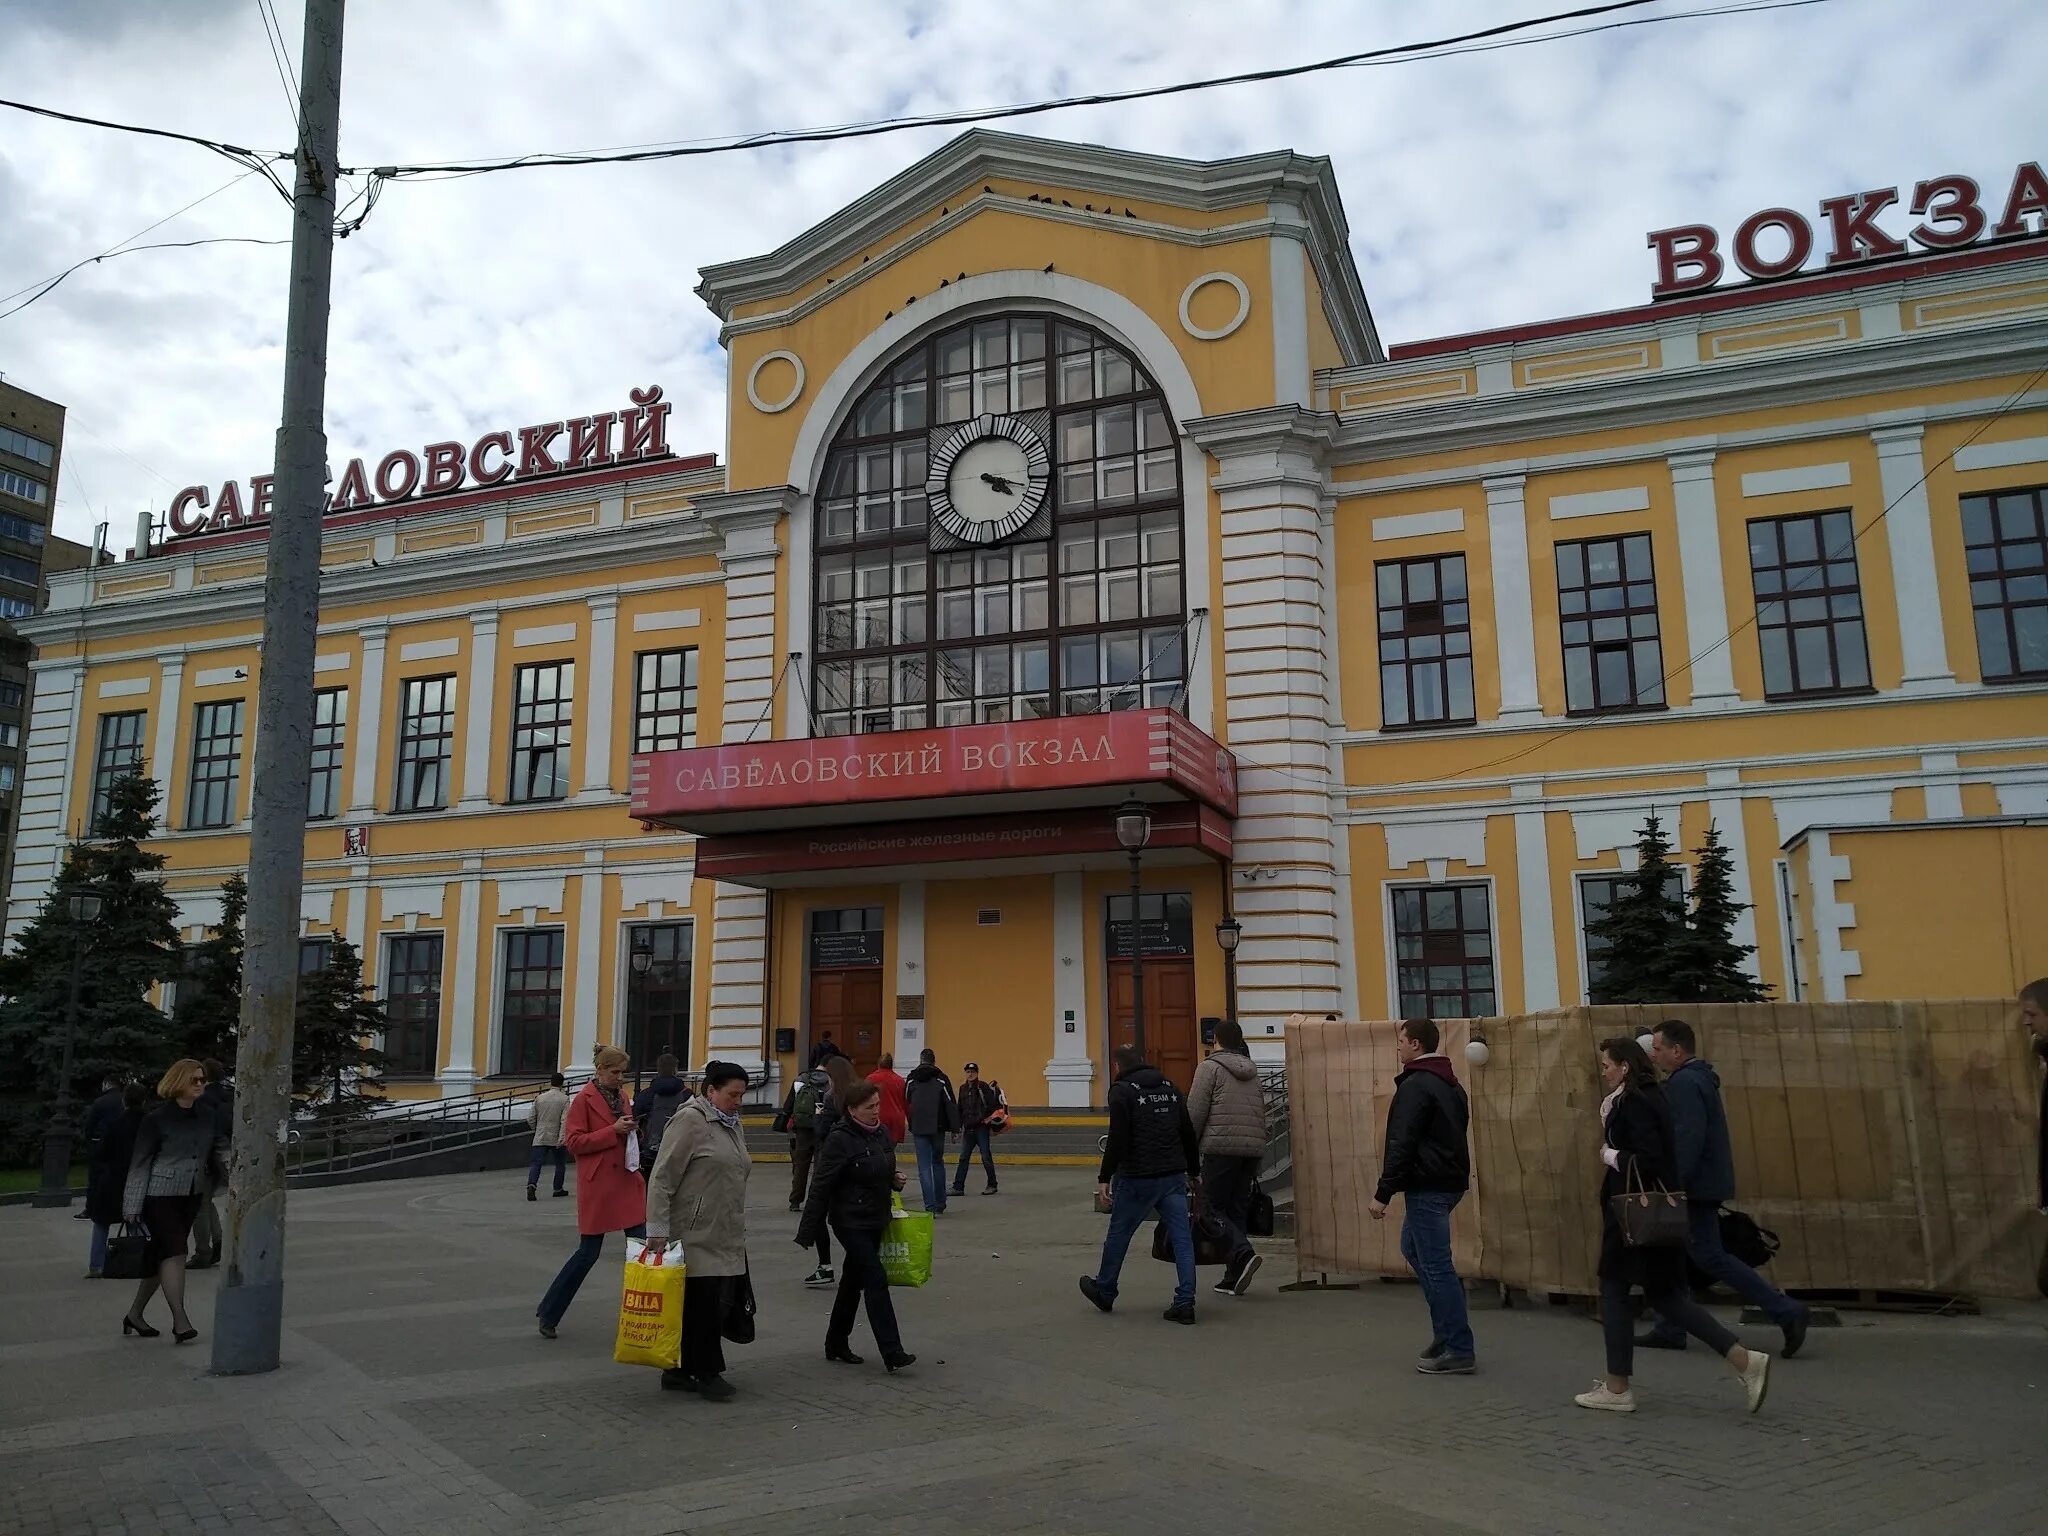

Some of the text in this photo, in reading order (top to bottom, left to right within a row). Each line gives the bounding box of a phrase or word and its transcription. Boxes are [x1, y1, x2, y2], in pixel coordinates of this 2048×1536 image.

[169, 385, 671, 535] САВЛОВСКИЙ
[675, 734, 1118, 794] САВЁЛОВСКИЙ ВОКЗАЛ
[808, 825, 1062, 854] Российские железные дороги
[1148, 1093, 1169, 1103] TEAM
[625, 1293, 660, 1310] BILLA
[625, 1320, 665, 1330] помогаю
